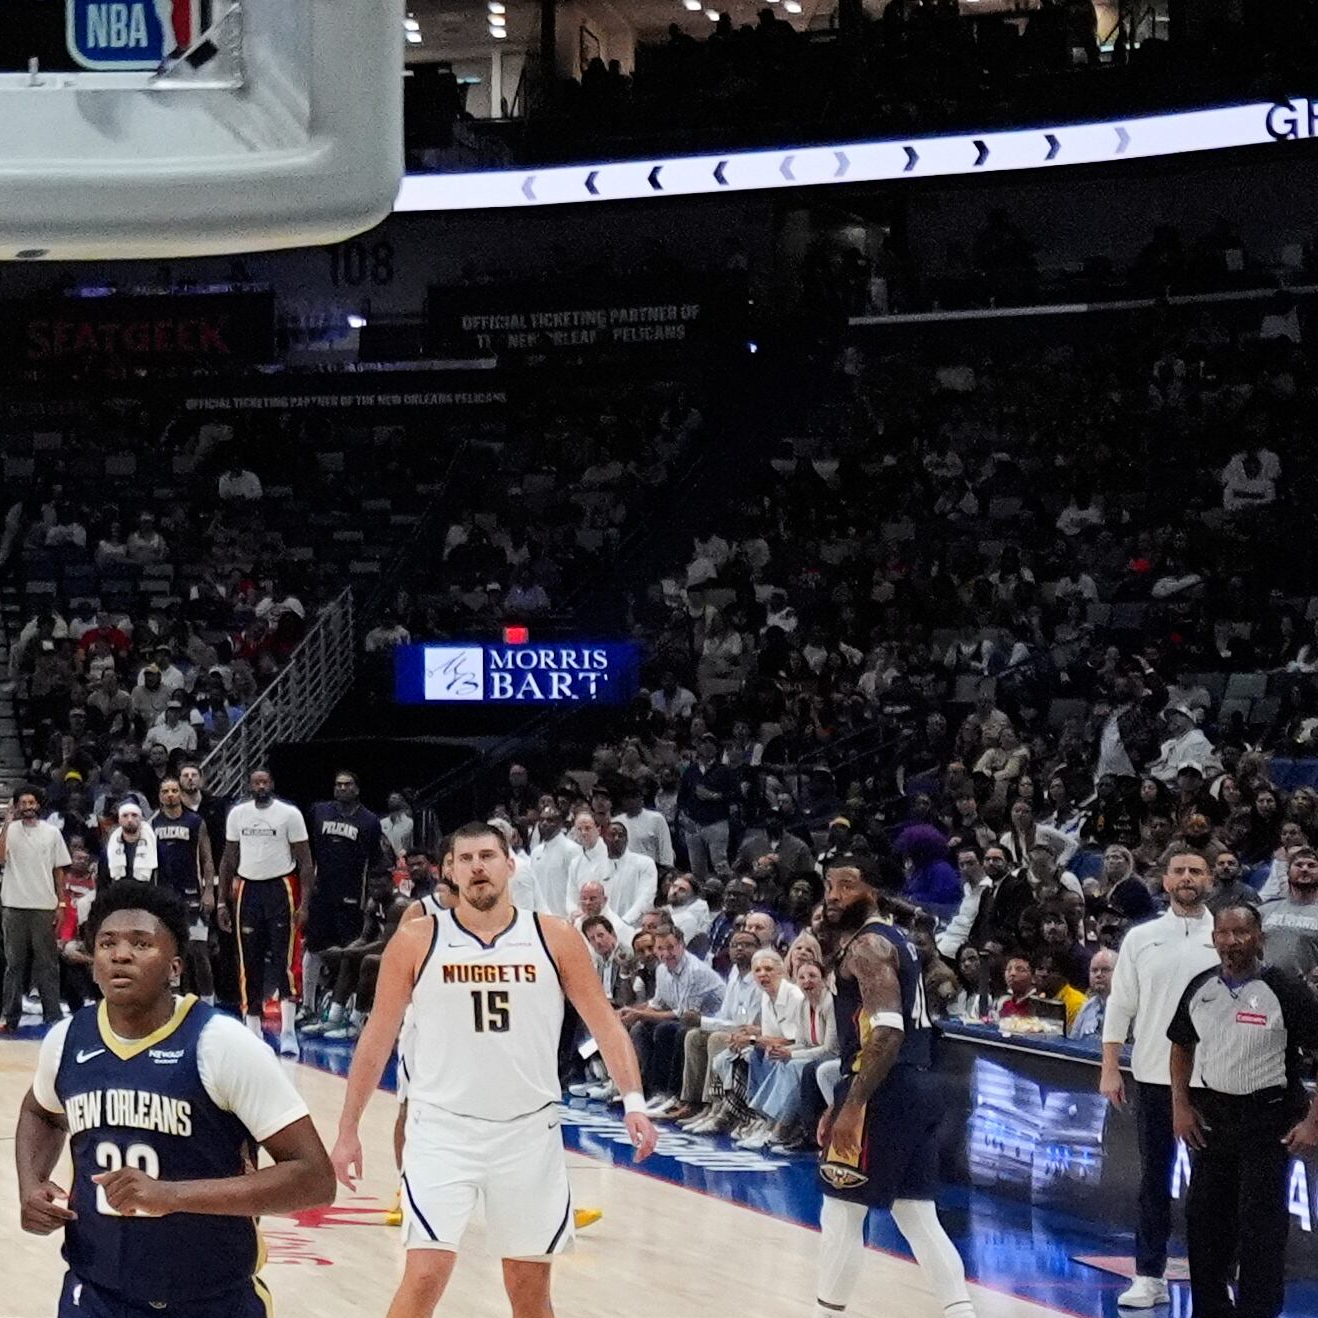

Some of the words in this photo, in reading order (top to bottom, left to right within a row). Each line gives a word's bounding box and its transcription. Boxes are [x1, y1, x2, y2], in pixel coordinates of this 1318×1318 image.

[86, 2, 147, 49] NBA
[326, 241, 394, 286] 108
[461, 315, 527, 331] OFFICIAL
[530, 310, 608, 329] TICKETING
[610, 307, 677, 324] PARTNER
[680, 304, 700, 321] OF
[25, 316, 231, 360] SEATGEEK
[613, 324, 686, 343] PELICANS
[488, 649, 608, 670] MORRIS
[489, 671, 608, 700] BART
[321, 821, 359, 841] PELICANS
[441, 964, 537, 984] NUGGETS
[470, 990, 510, 1033] 15
[65, 1089, 103, 1136] NEW
[105, 1088, 192, 1138] ORLEANS
